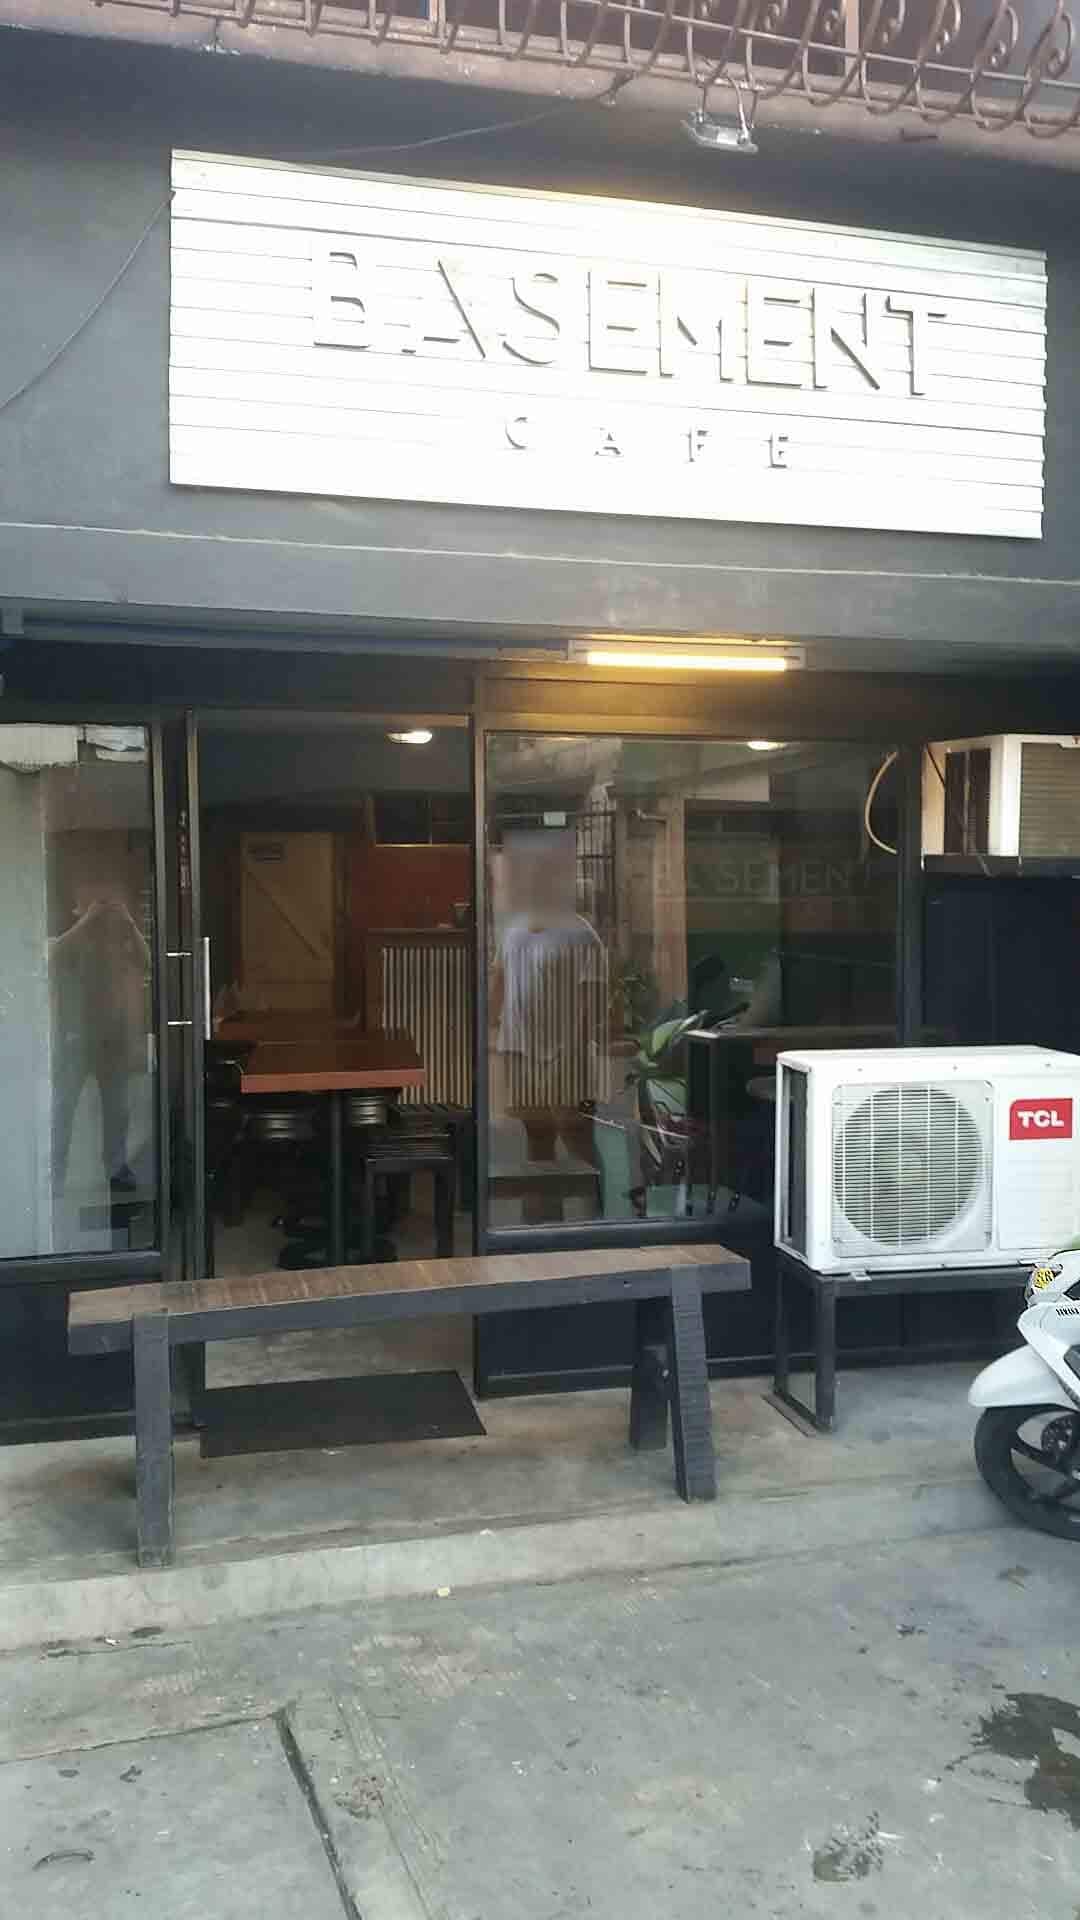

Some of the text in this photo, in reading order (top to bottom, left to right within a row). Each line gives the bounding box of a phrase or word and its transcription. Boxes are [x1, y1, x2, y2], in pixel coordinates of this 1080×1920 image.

[309, 243, 949, 397] BASEMENT
[503, 412, 790, 469] CAFE
[1017, 1110, 1064, 1128] TCL
